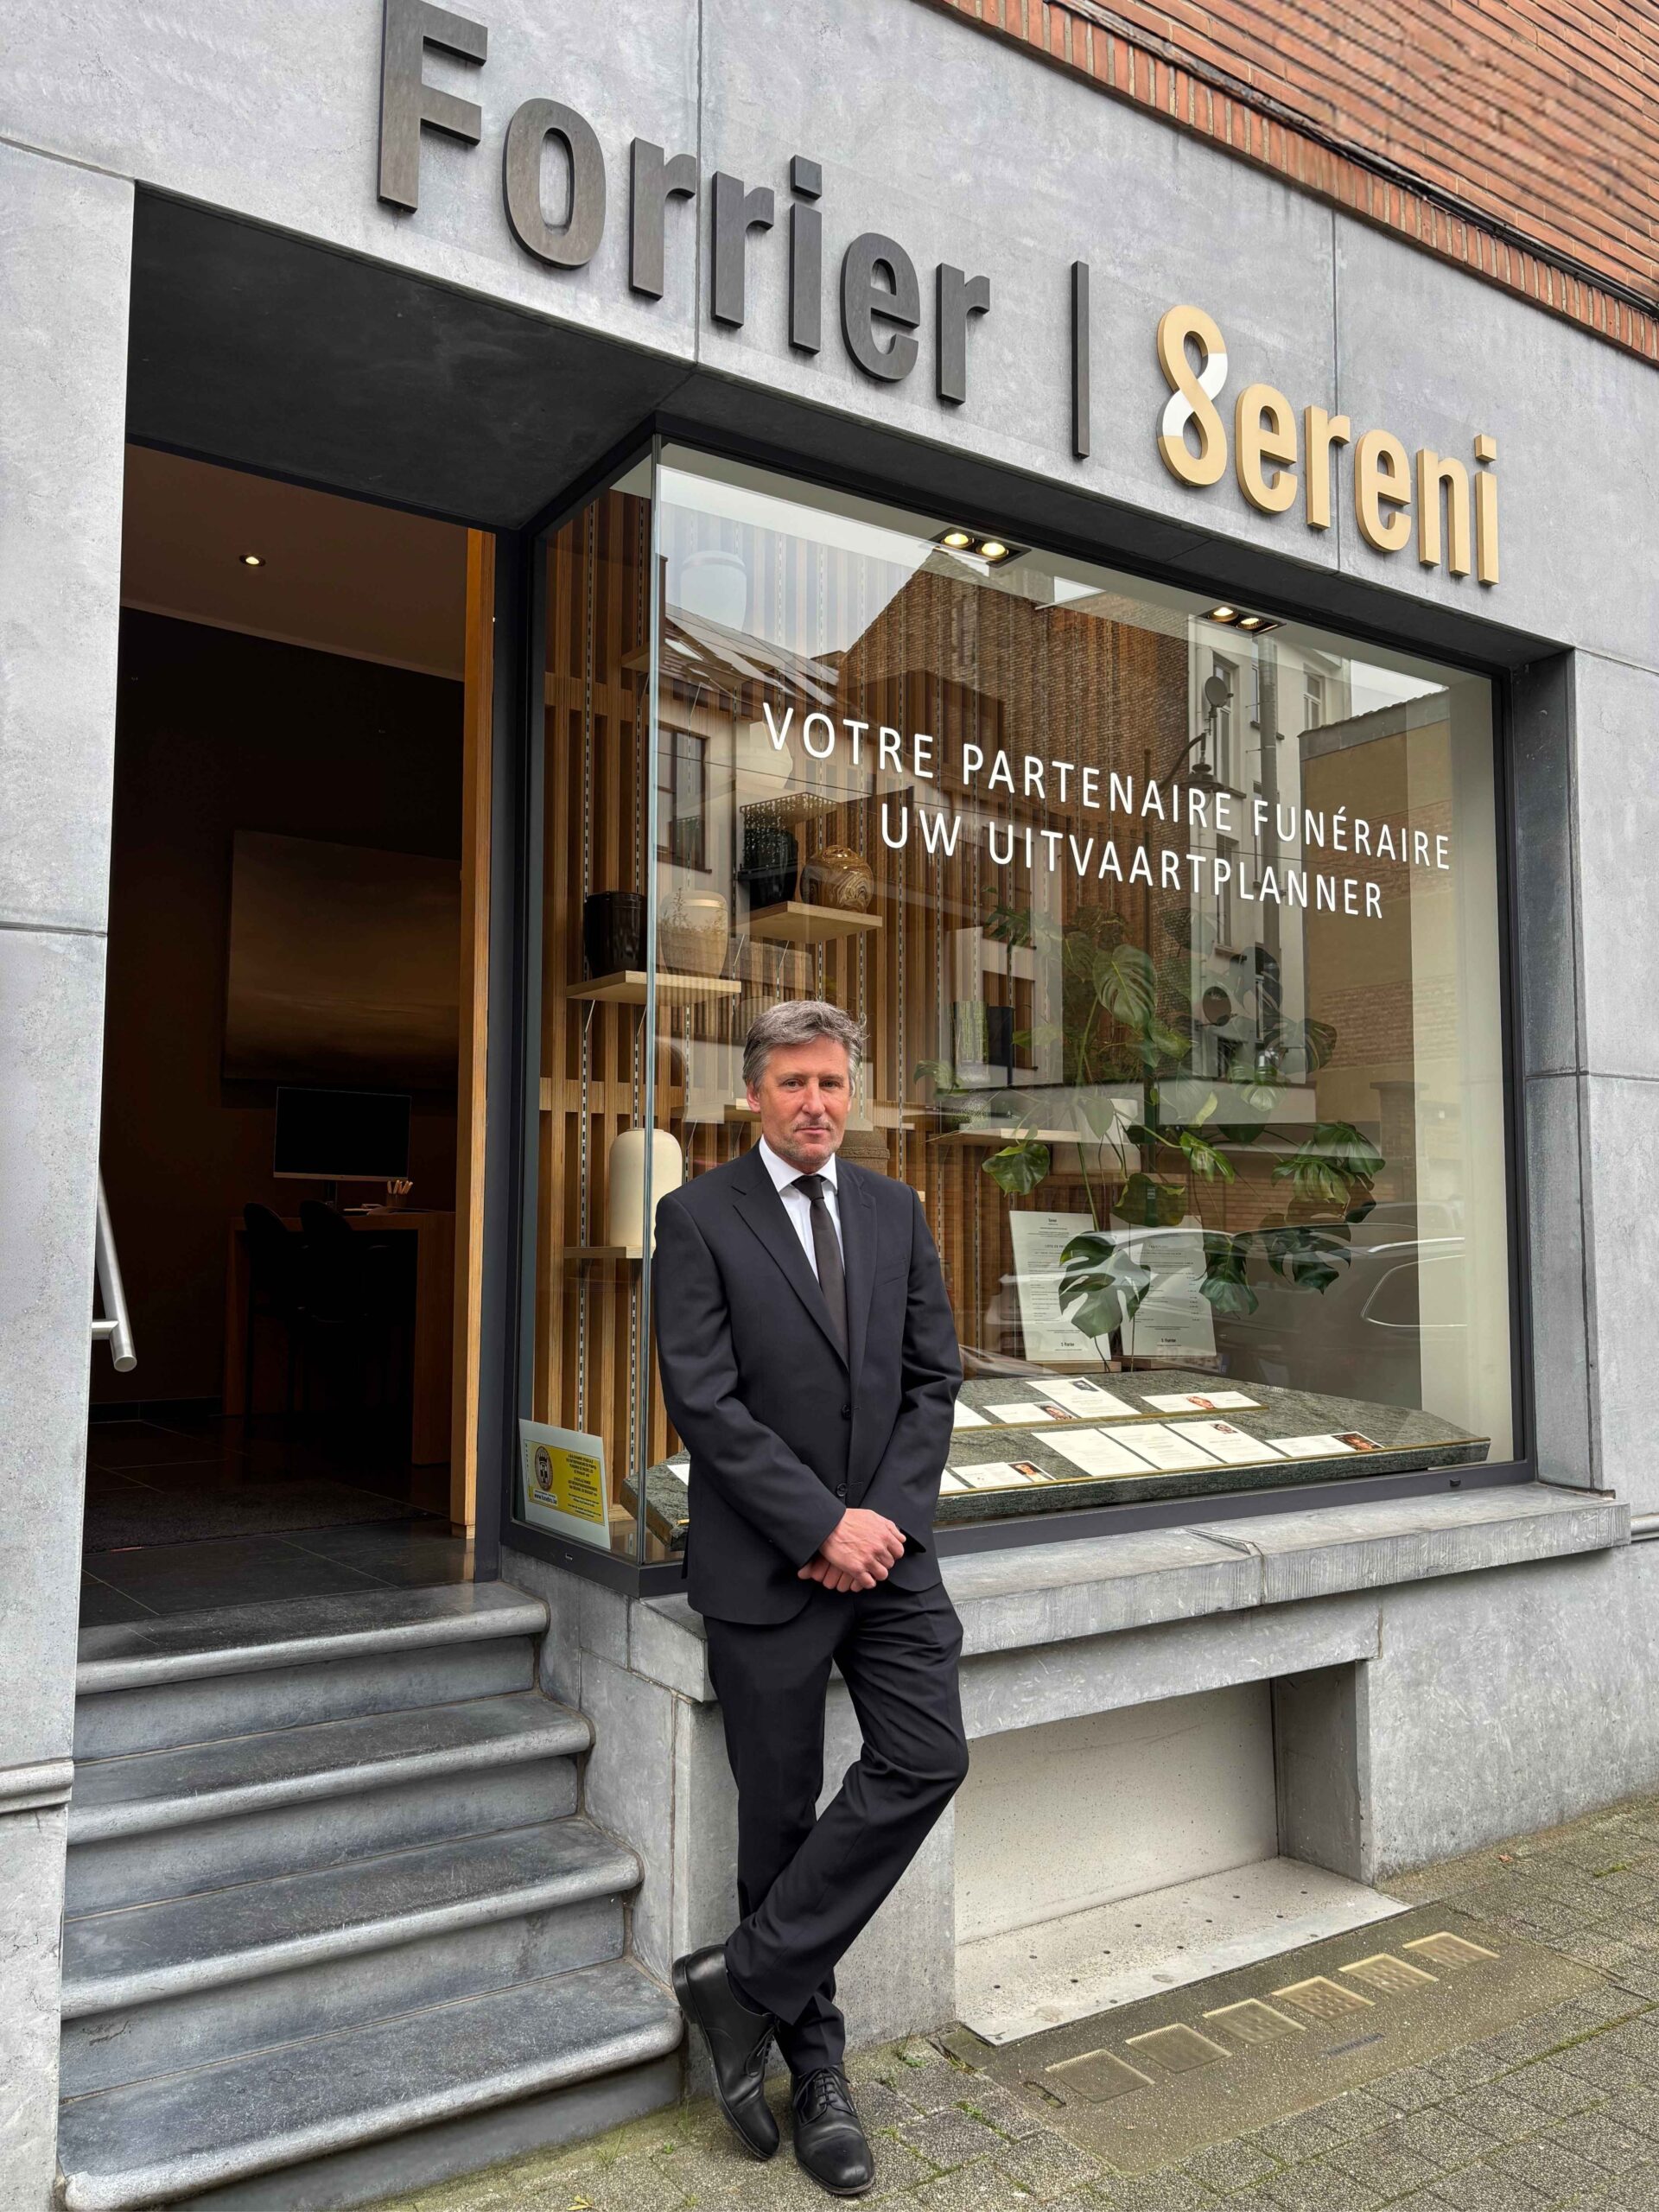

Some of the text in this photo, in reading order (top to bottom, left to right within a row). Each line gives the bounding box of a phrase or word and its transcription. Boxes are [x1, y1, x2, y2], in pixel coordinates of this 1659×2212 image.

[377, 0, 991, 406] Forrier
[762, 702, 1451, 870] VOTRE PARTENAIRE FUNÉRAIRE
[880, 803, 1383, 918] UW UITVAARTPLANNER
